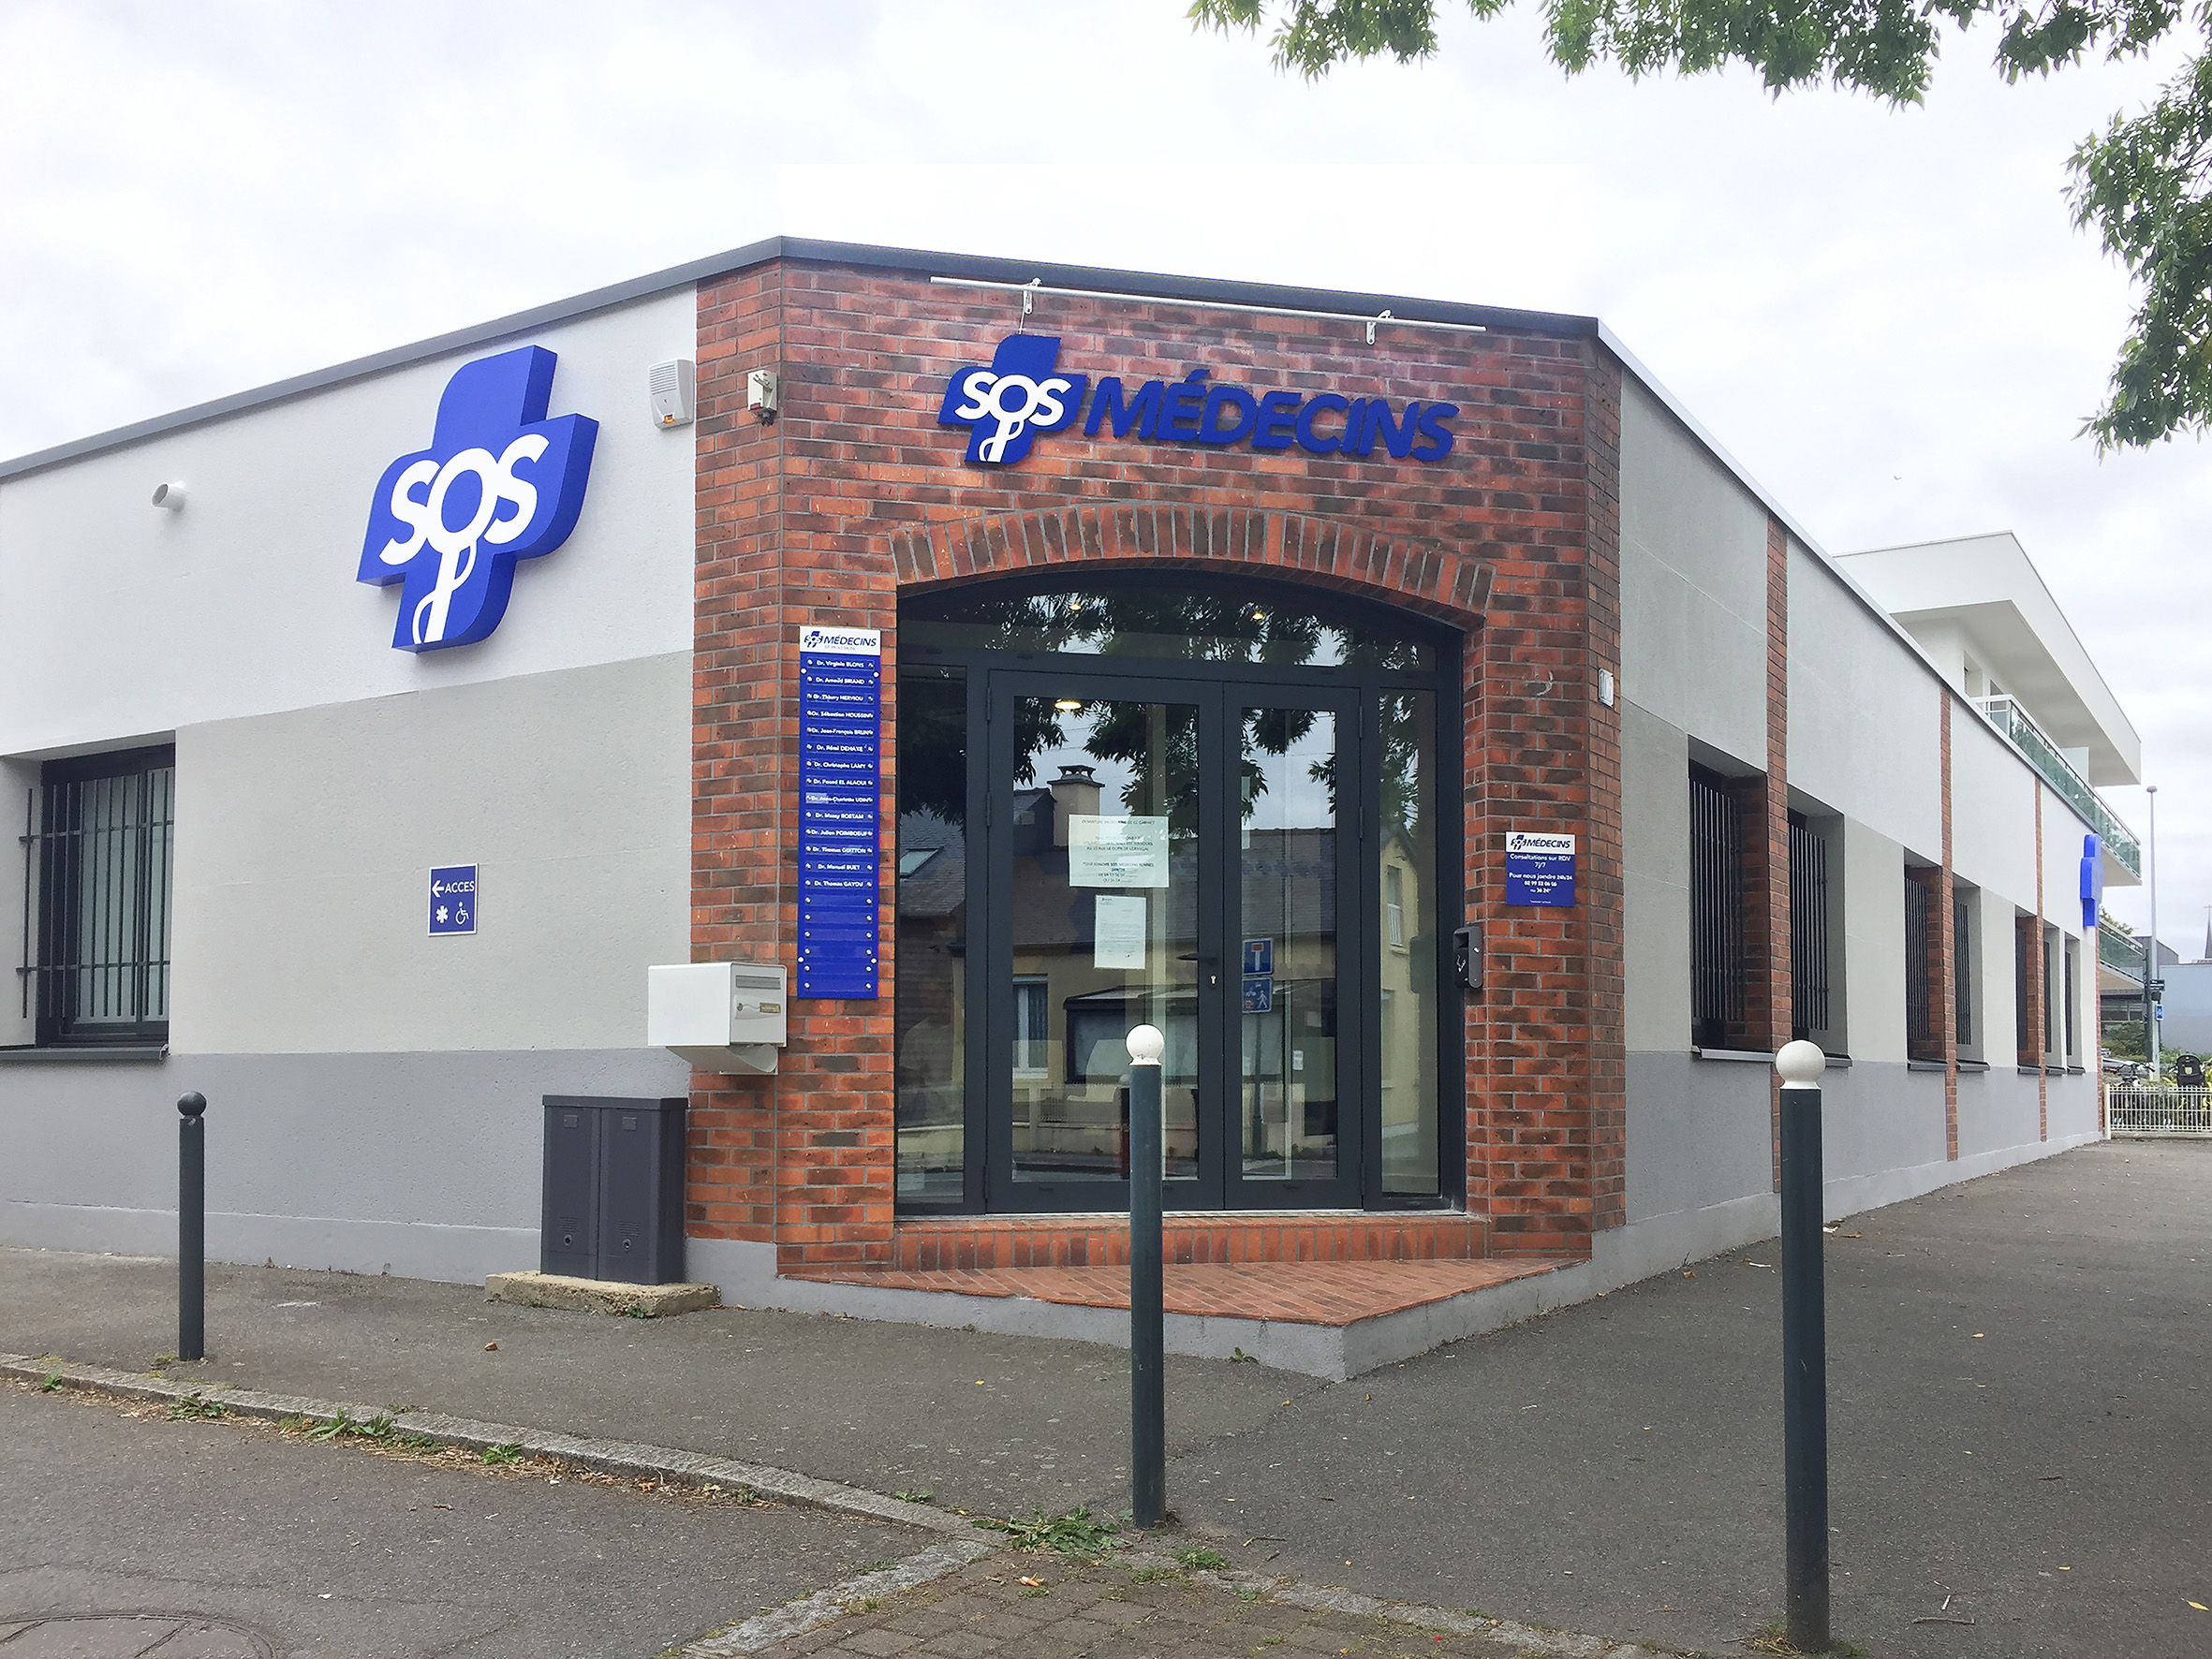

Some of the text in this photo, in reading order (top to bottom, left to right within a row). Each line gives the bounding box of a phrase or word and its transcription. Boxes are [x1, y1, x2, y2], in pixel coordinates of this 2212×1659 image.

[954, 369, 1461, 462] SOS MÉDECINS
[379, 433, 551, 565] SOS
[824, 635, 877, 647] MÉDECINS
[1526, 838, 1571, 848] MÉDECINS
[445, 881, 475, 894] ACCES
